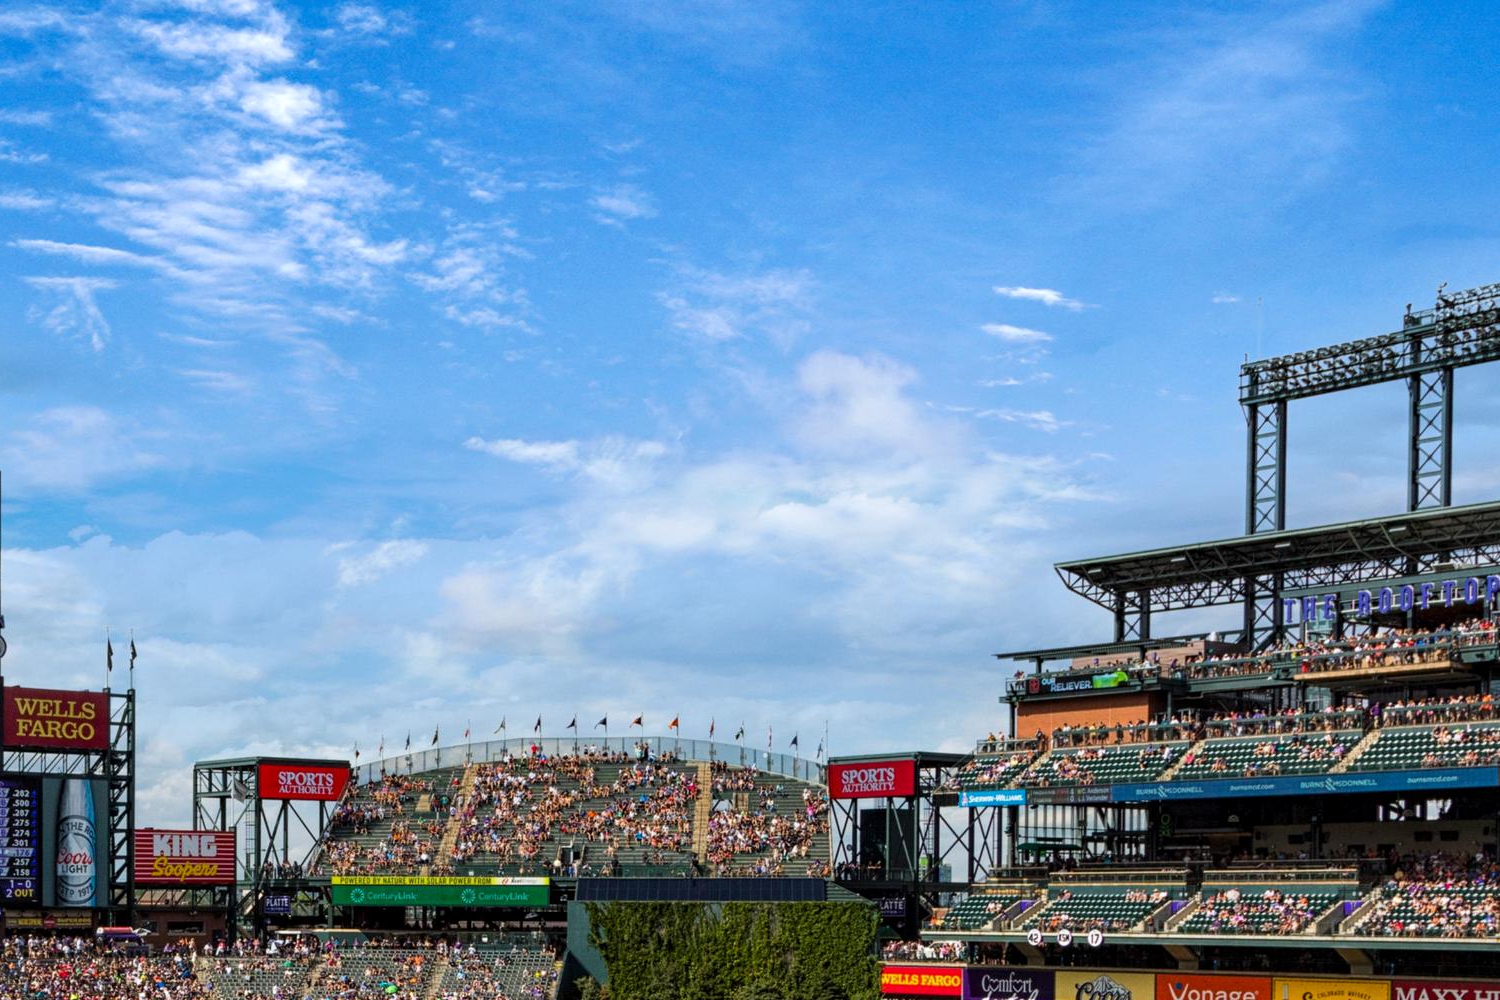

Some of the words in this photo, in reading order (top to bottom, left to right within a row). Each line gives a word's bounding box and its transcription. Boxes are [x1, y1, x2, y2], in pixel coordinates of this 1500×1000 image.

[1284, 593, 1338, 623] THE
[1357, 575, 1500, 617] ROOFTOP
[14, 698, 95, 720] WELLS
[16, 719, 95, 740] FARGO
[278, 771, 333, 787] SPORTS
[841, 768, 895, 785] SPORTS
[1300, 781, 1325, 789] BURNS
[1136, 788, 1157, 796] BURNS
[67, 822, 83, 832] THE
[152, 834, 217, 857] KING
[56, 849, 93, 865] Coors
[62, 865, 88, 874] LIGHT
[151, 856, 218, 881] Soopers
[340, 877, 371, 885] POWERED
[383, 877, 406, 885] NATURE
[409, 877, 425, 885] WITH
[14, 889, 34, 897] OUT
[367, 891, 418, 901] CenturyLink
[479, 892, 528, 901] CenturyLink
[266, 898, 289, 907] PLATTE
[878, 900, 905, 910] LATTE
[1028, 933, 1039, 943] 42
[1091, 933, 1099, 944] 17
[882, 974, 919, 986] WELLS
[921, 975, 961, 987] FARGO
[981, 972, 1032, 993] Comfort
[1317, 990, 1344, 999] COLORADO
